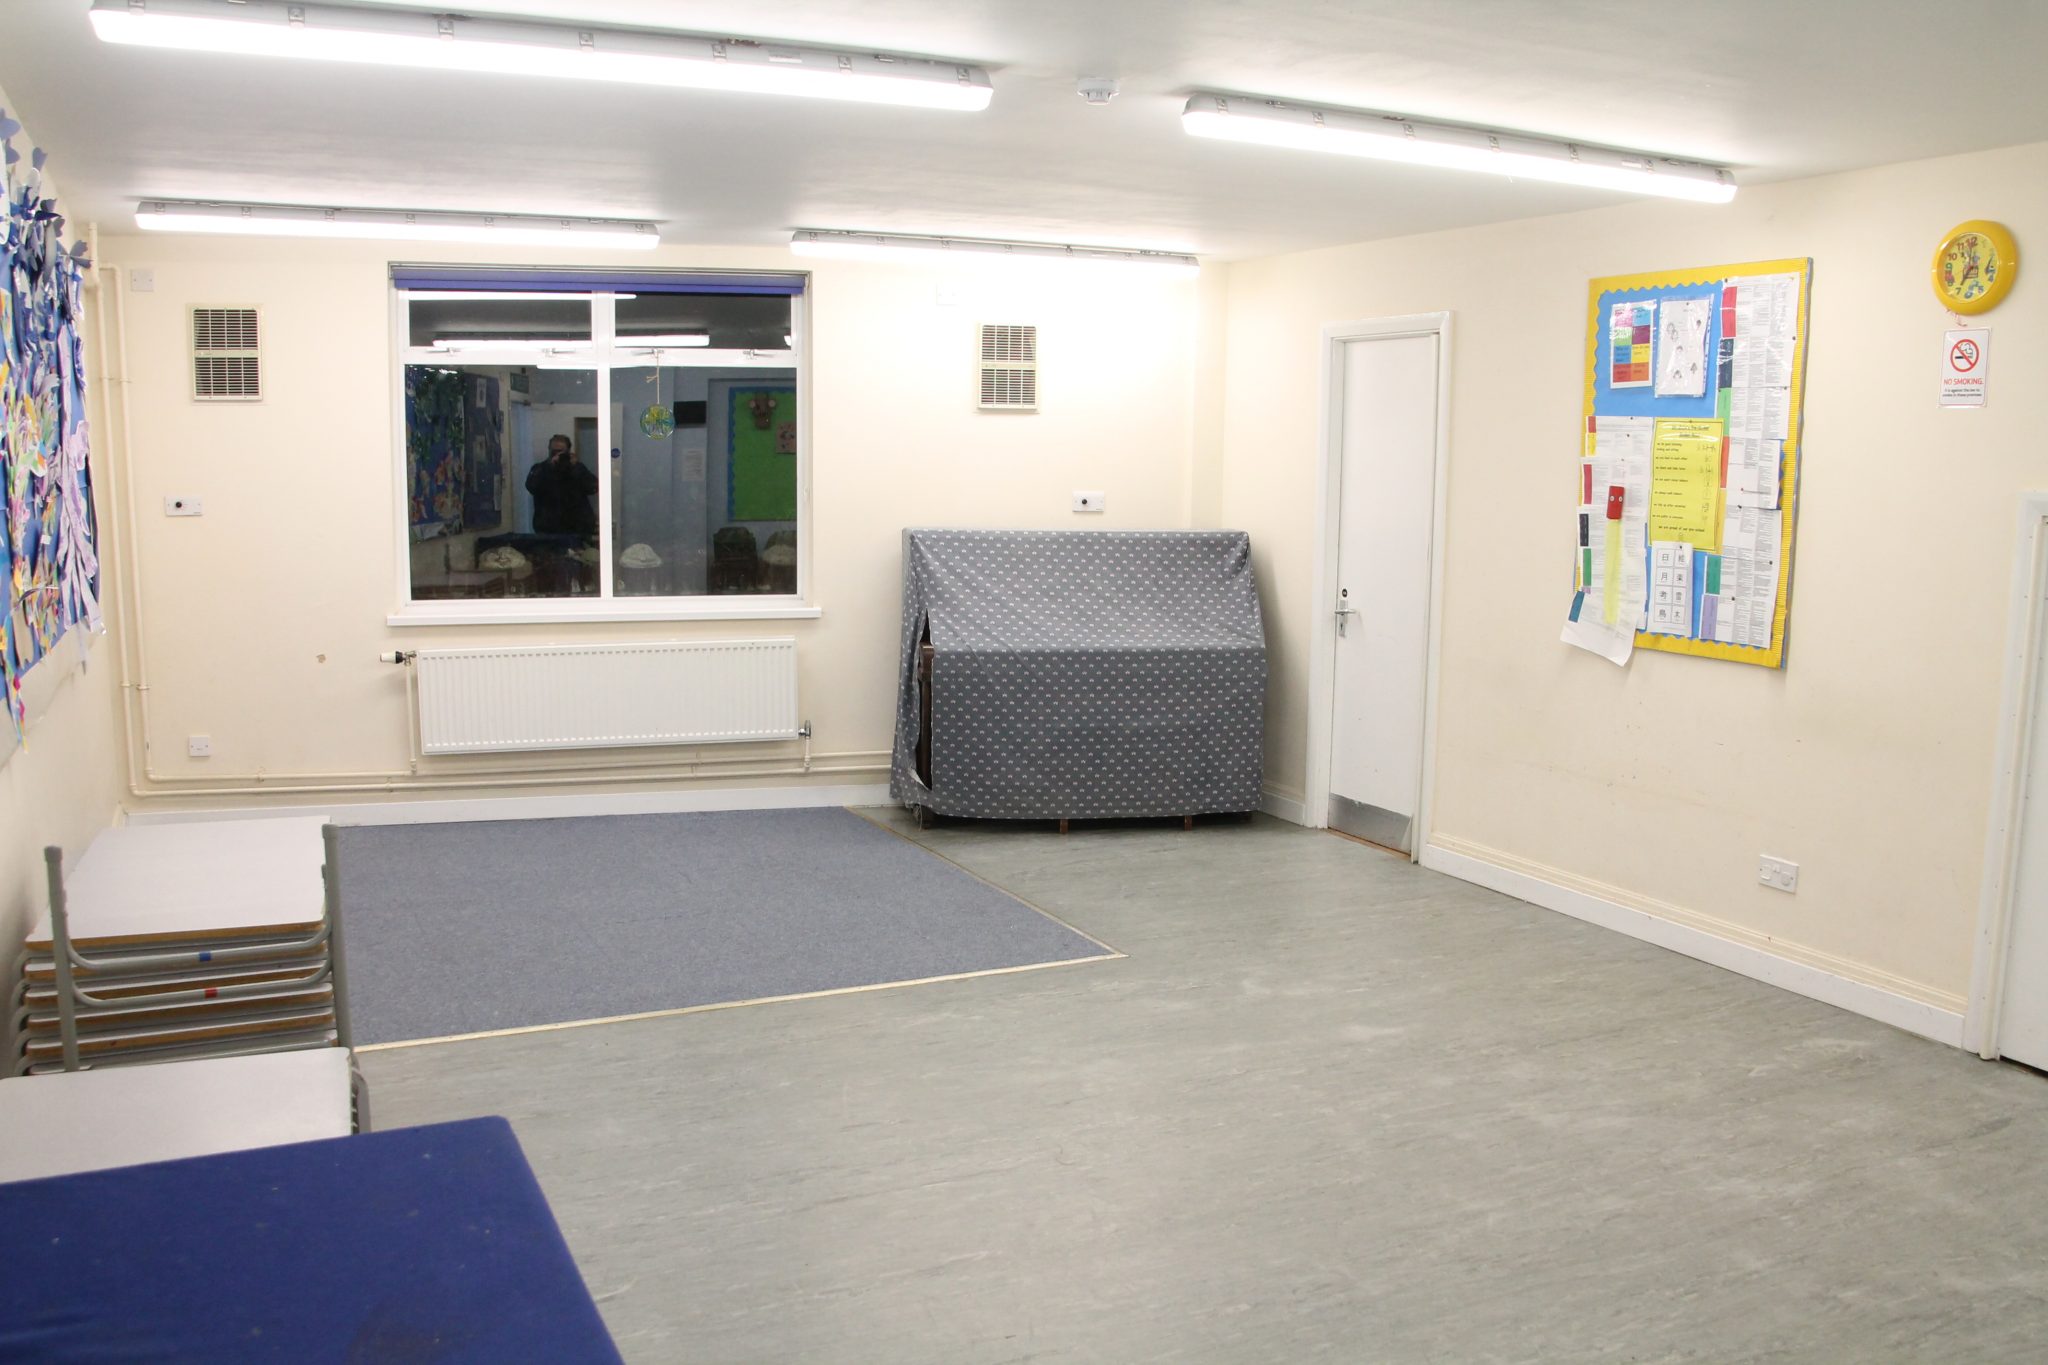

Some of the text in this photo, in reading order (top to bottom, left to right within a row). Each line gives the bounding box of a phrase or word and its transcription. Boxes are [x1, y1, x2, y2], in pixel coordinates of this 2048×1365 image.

[1966, 236, 1978, 247] 12
[1947, 252, 1957, 261] 10
[1955, 287, 1961, 295] 7
[1661, 572, 1668, 581] 月
